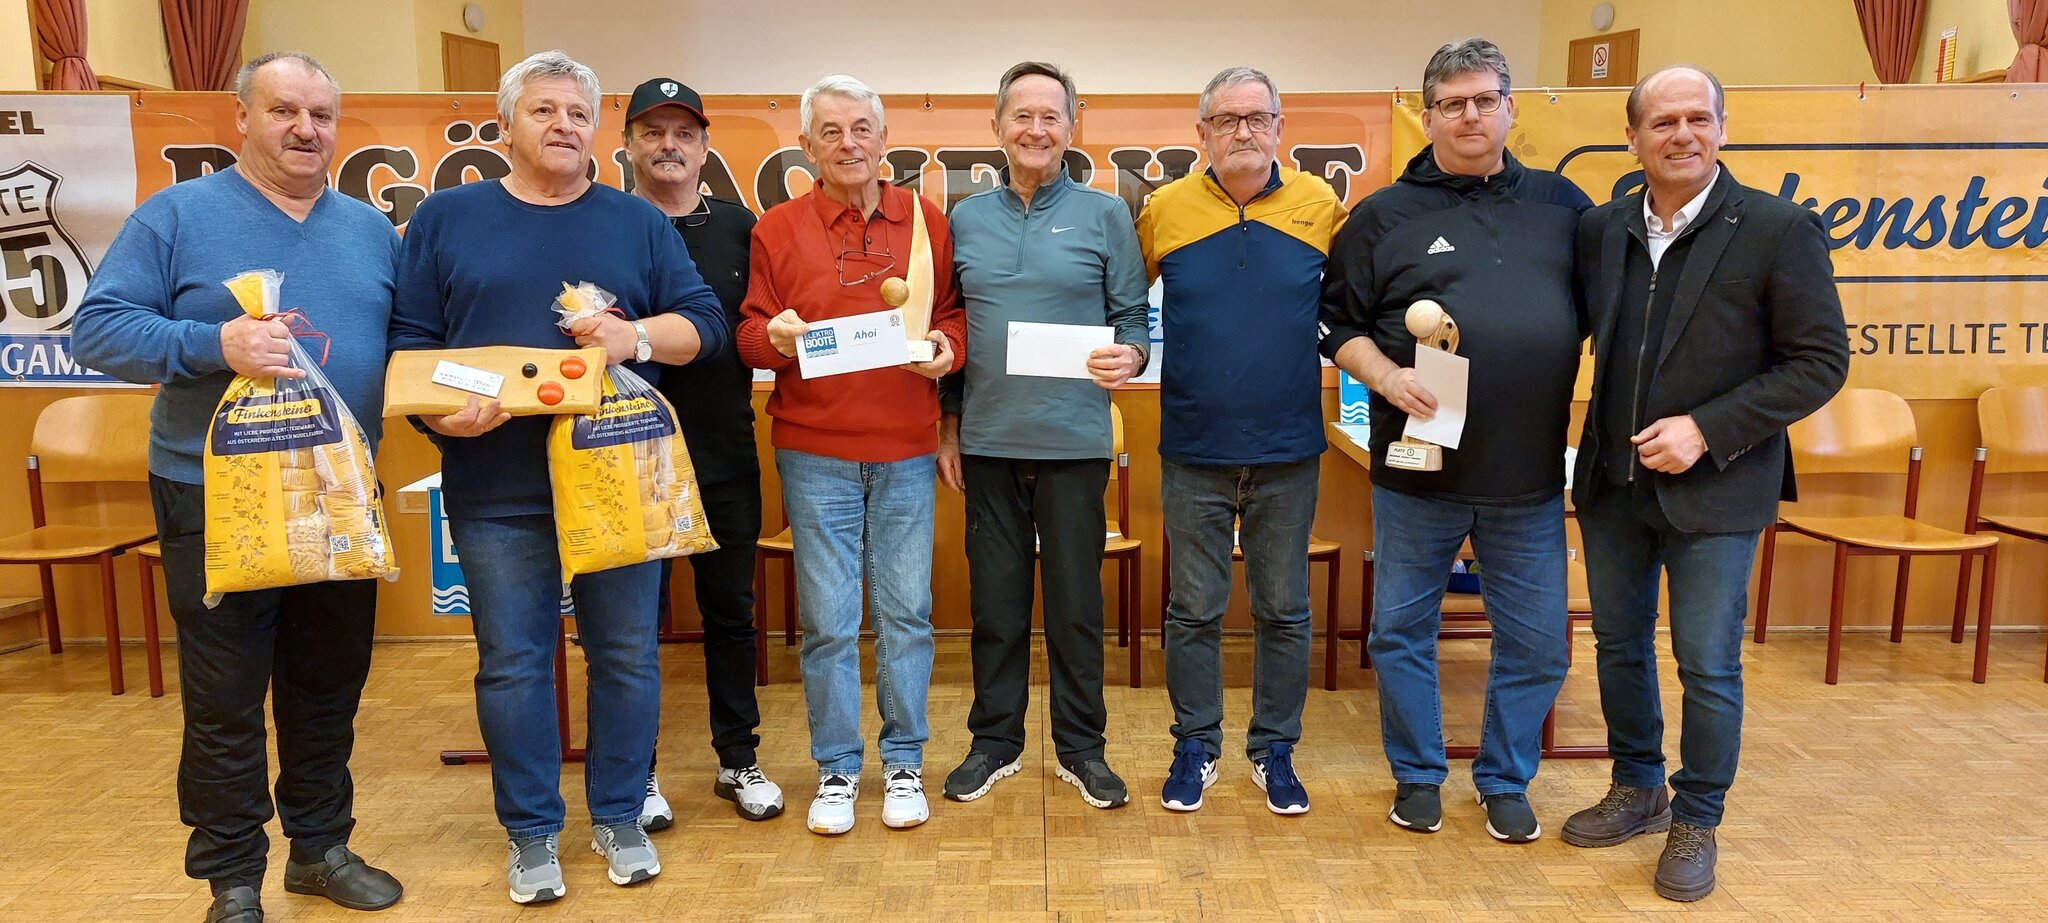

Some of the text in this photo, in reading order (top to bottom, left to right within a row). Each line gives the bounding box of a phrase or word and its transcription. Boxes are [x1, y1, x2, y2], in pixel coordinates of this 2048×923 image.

[0, 231, 68, 323] 5
[804, 328, 834, 340] ELEKTRO
[853, 328, 878, 341] Ahoi
[804, 336, 836, 349] BOOTE
[2, 343, 105, 376] GAM
